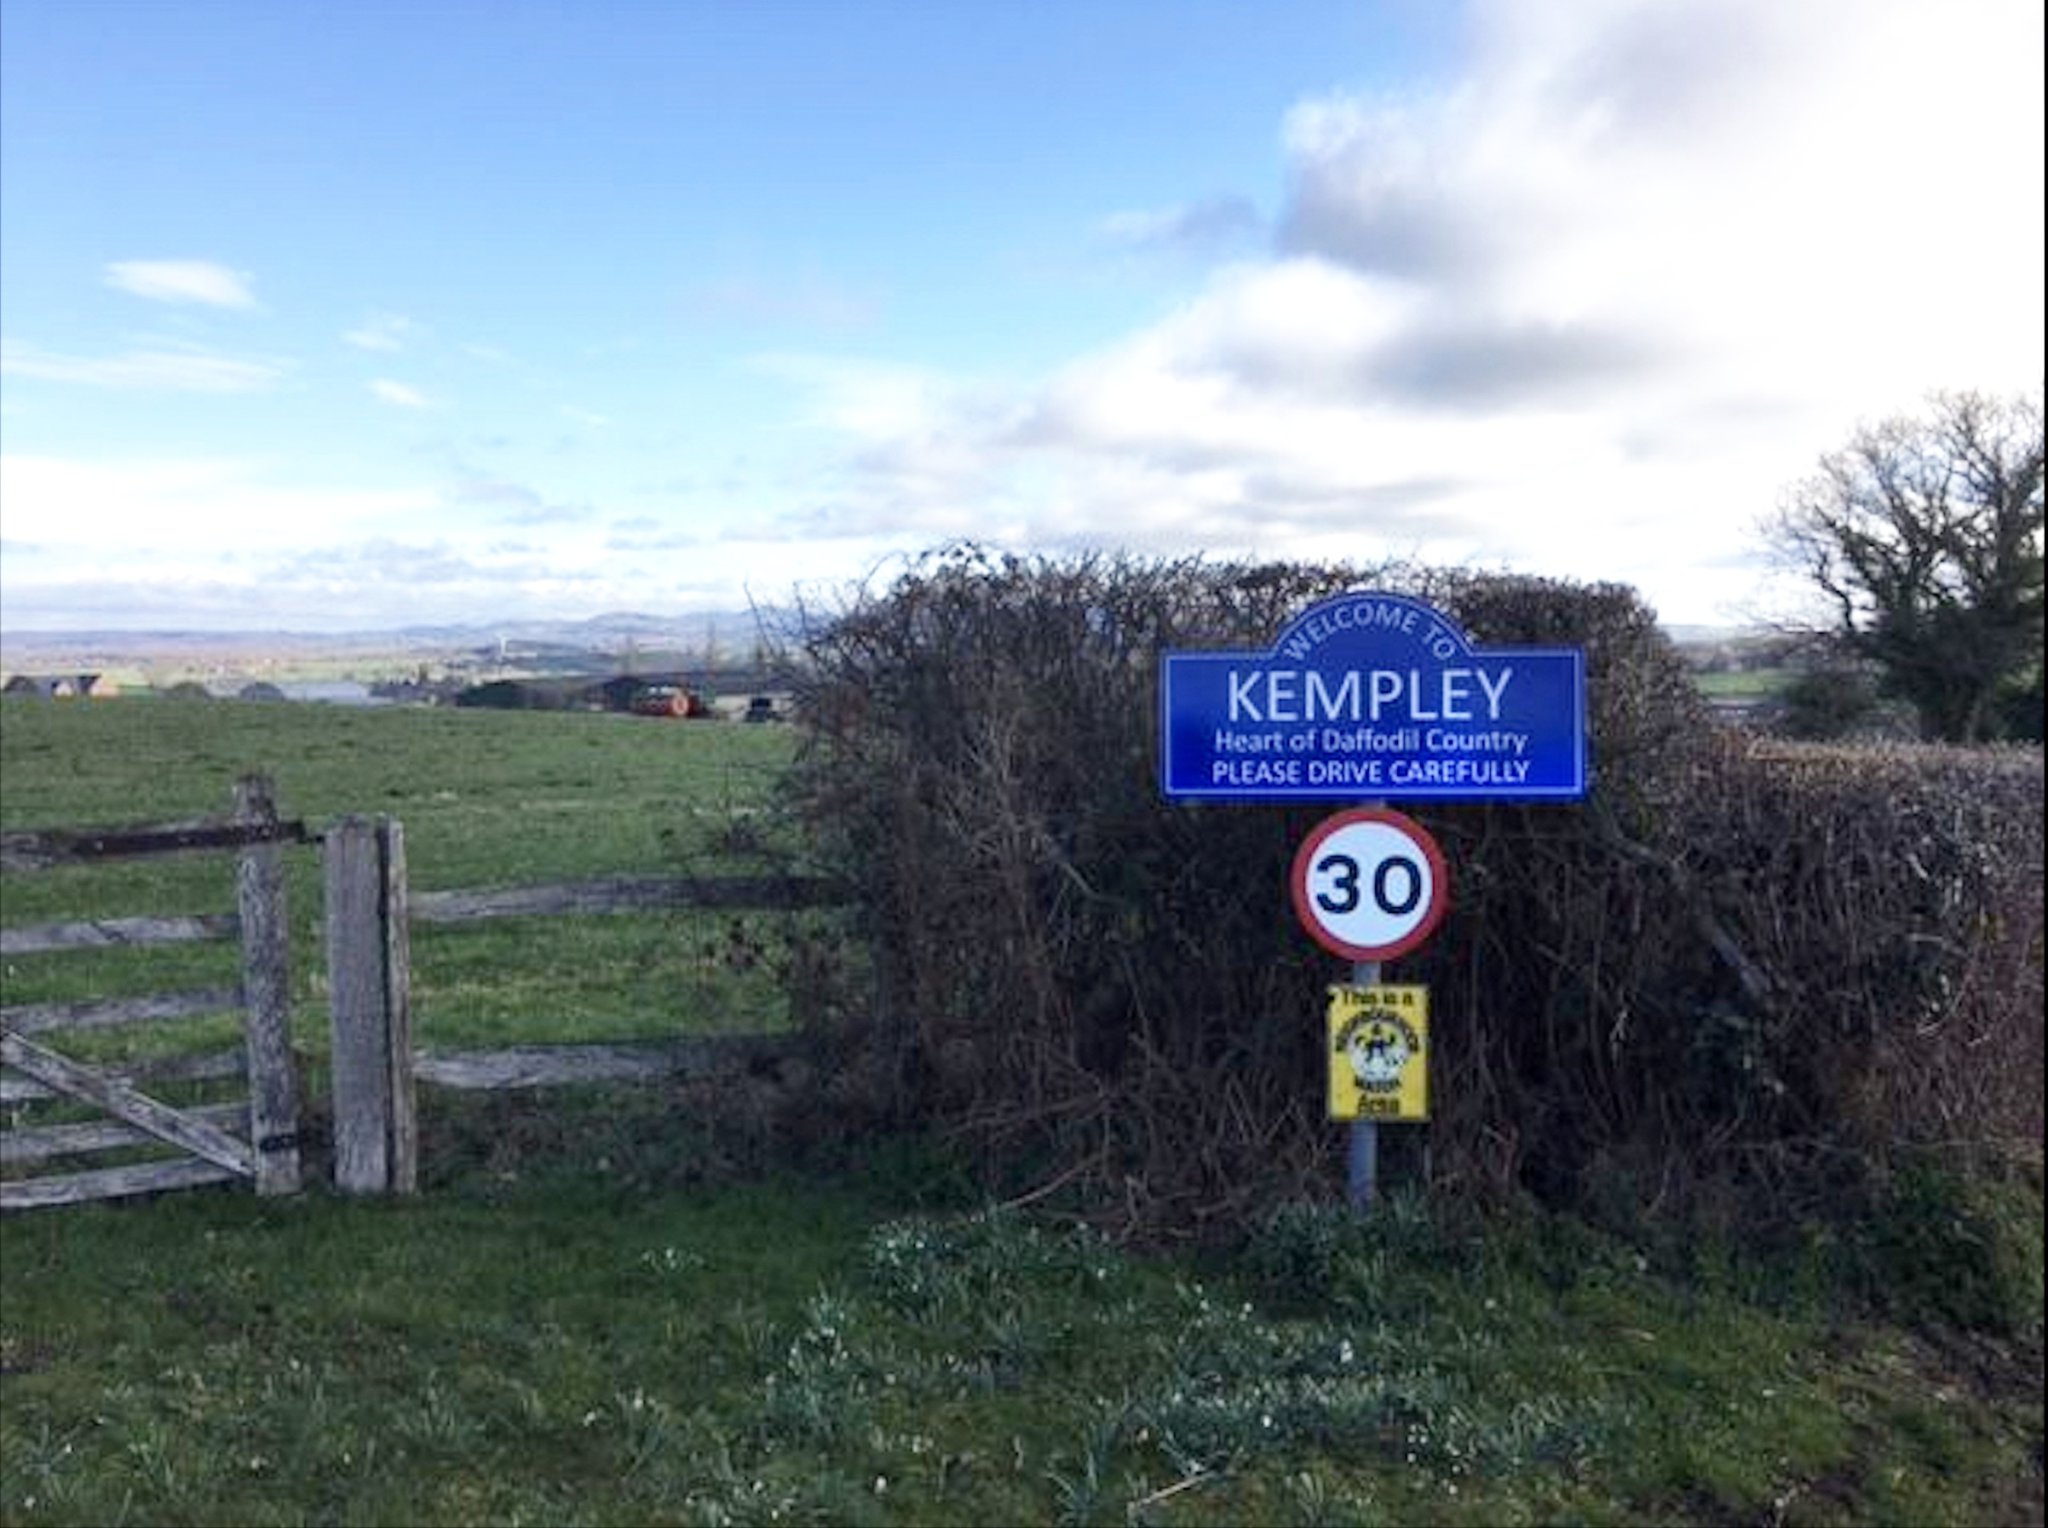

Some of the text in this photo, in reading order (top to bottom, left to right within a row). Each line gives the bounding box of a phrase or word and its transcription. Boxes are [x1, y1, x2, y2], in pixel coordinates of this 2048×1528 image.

[1284, 602, 1457, 661] WELCOME TO
[1227, 669, 1513, 722] KEMPLEY
[1216, 729, 1529, 756] Heart of Daffodil Country
[1212, 760, 1531, 784] PLEASE DRIVE CAREFULLY
[1316, 854, 1422, 916] 30
[1342, 989, 1377, 1006] This
